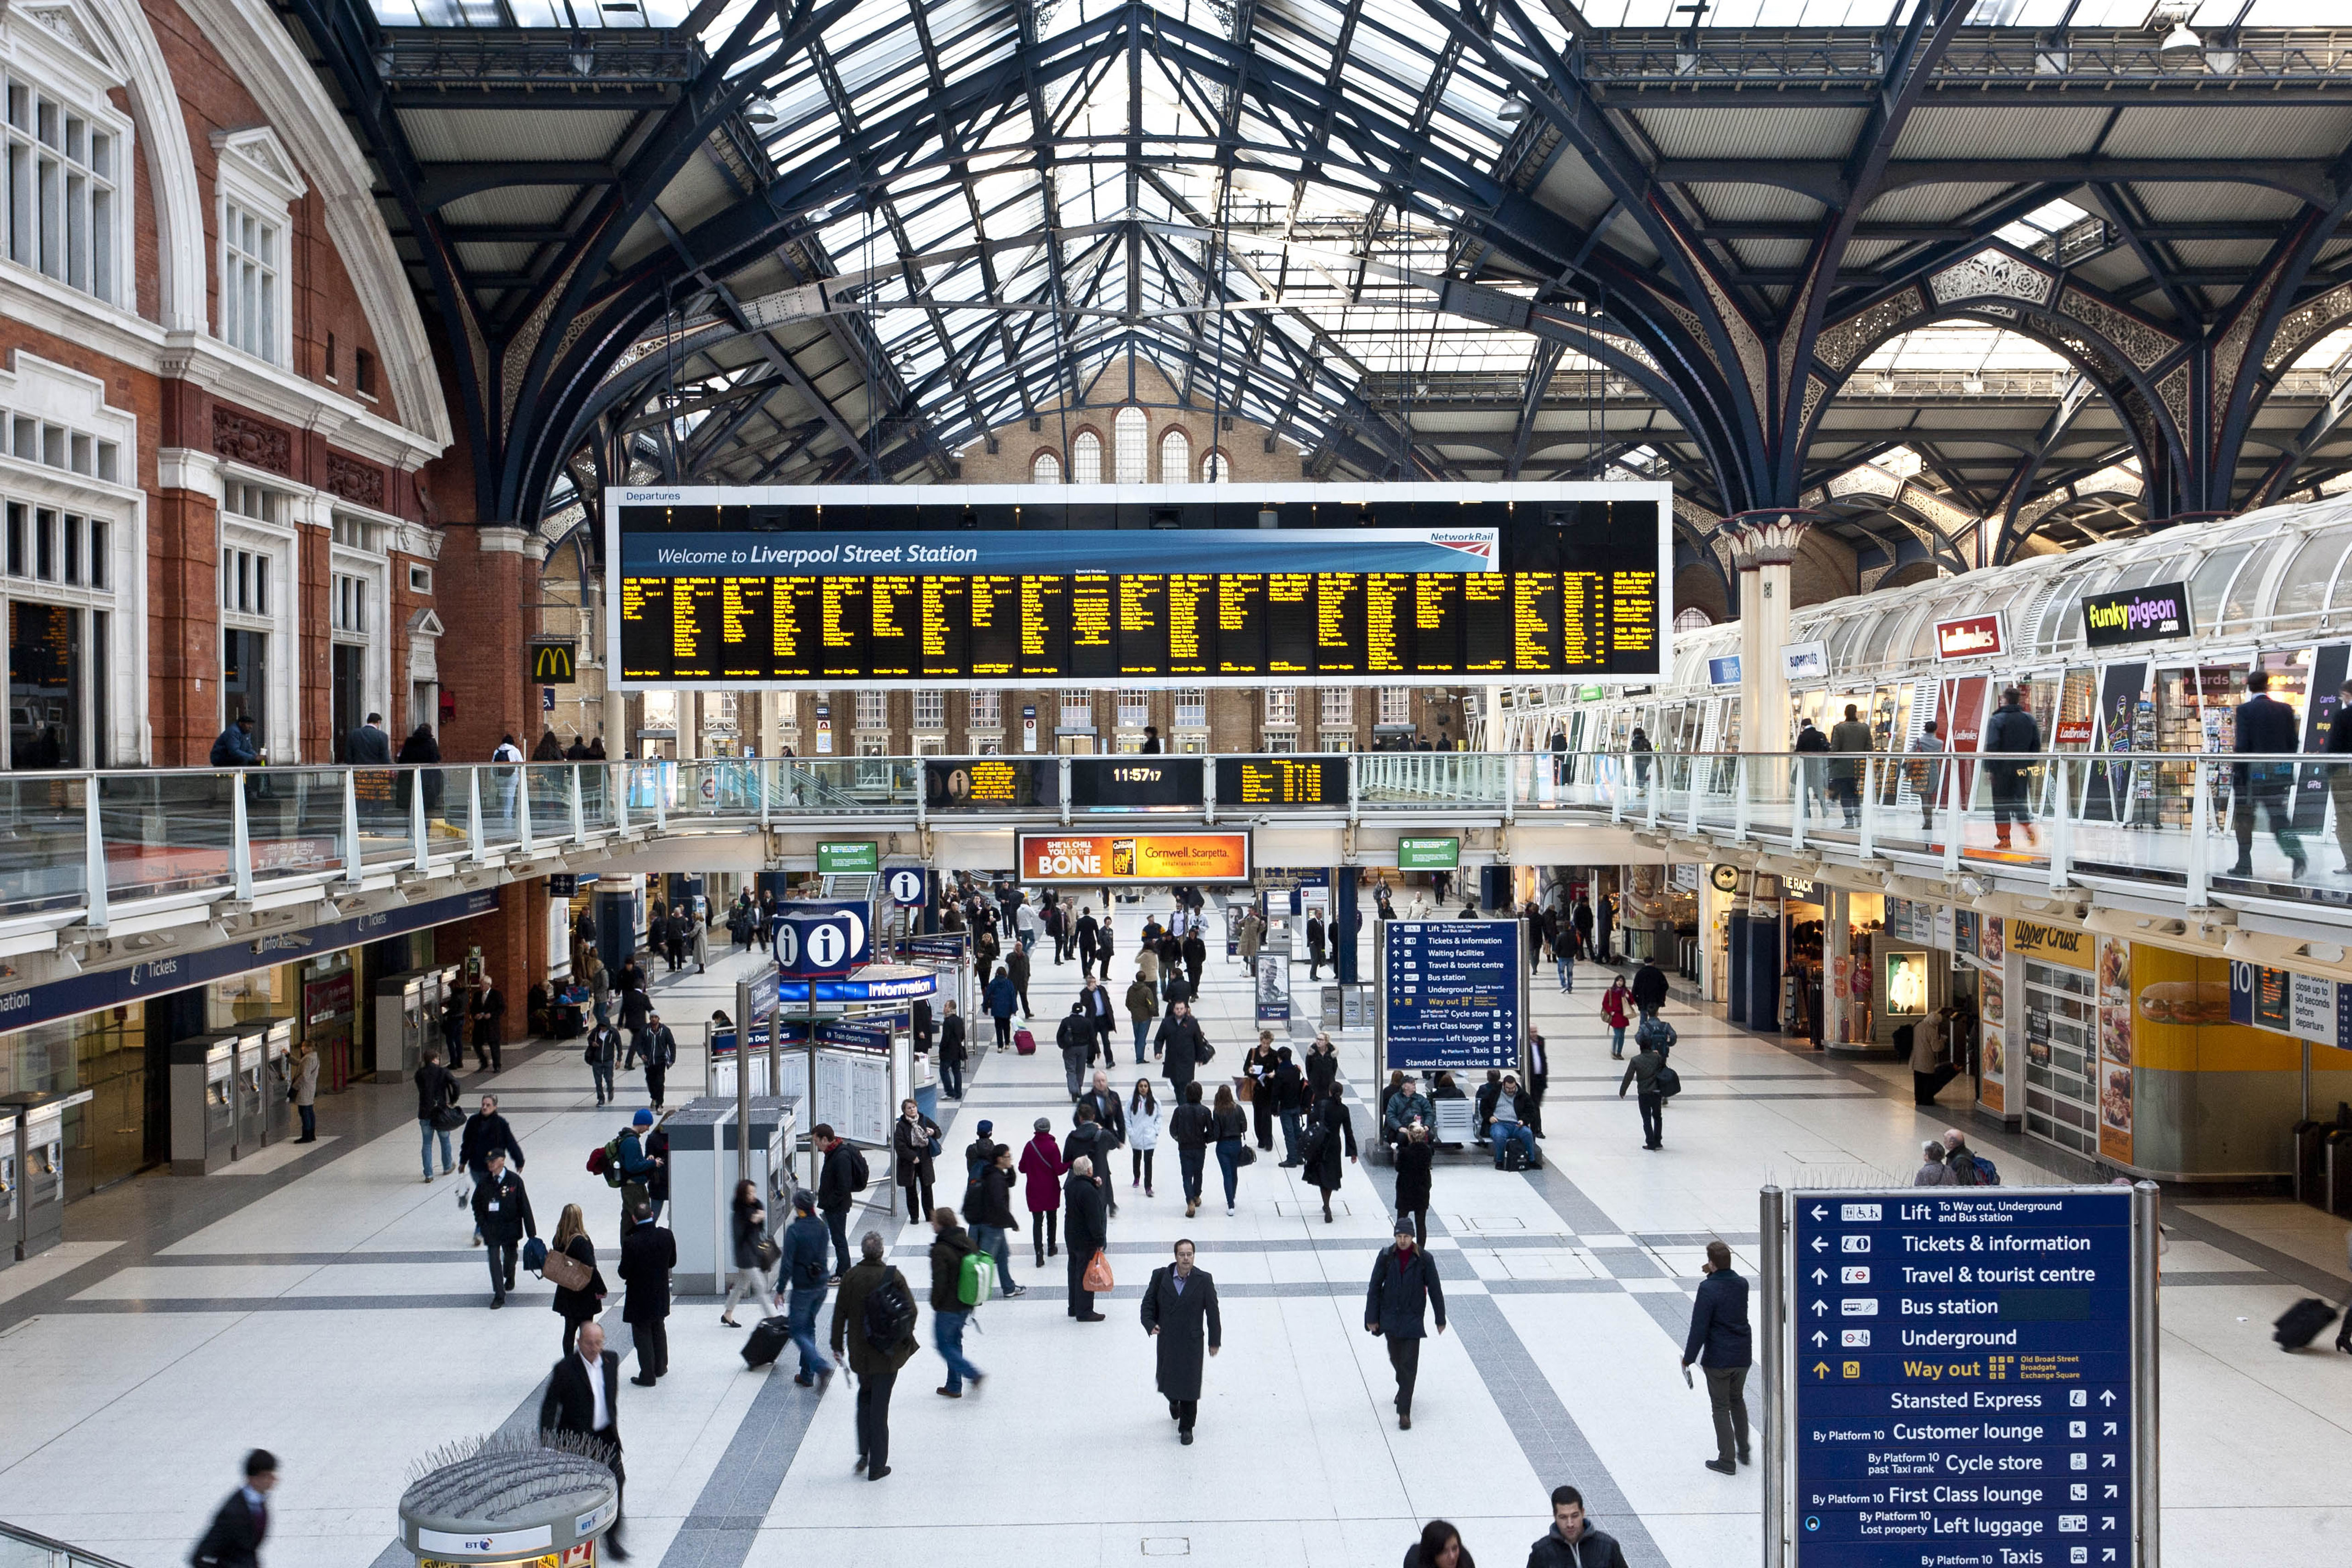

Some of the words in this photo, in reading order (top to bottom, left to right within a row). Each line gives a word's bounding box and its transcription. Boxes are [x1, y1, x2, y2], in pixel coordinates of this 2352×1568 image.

[626, 492, 680, 502] Departures
[658, 548, 727, 563] Welcome
[731, 550, 746, 563] to
[751, 544, 839, 568] Liverpool
[842, 544, 903, 563] Street
[906, 544, 978, 562] Station
[2160, 619, 2178, 632] .com
[1790, 651, 1818, 670] supercuts
[2320, 695, 2336, 704] Cards
[2059, 726, 2091, 740] Ladbrokes
[2317, 722, 2331, 731] Wrap
[2307, 780, 2321, 789] Gifts
[1145, 846, 1190, 858] Cornwell.
[1192, 848, 1229, 860] Scarpetta.
[1039, 855, 1101, 874] BONE
[1781, 875, 1793, 889] TIE
[1793, 877, 1813, 893] RACK
[368, 913, 386, 927] Tickets
[2015, 920, 2047, 947] Upper
[2047, 927, 2082, 952] Crust
[1428, 950, 1454, 958] Waiting
[147, 959, 177, 978] Tickets
[2230, 960, 2251, 993] 10
[868, 980, 931, 997] Information
[1428, 986, 1473, 995] Underground
[2295, 983, 2311, 993] close
[2312, 986, 2320, 995] up
[2322, 987, 2328, 996] to
[1428, 998, 1445, 1007] Way
[2295, 994, 2303, 1002] 30
[2304, 996, 2329, 1008] seconds
[1451, 1010, 1470, 1019] Cycle
[2295, 1007, 2314, 1017] before
[1459, 1022, 1483, 1031] lounge
[2295, 1018, 2324, 1032] departure
[846, 1032, 871, 1044] departures
[1462, 1034, 1489, 1043] luggage
[1438, 1059, 1465, 1067] Express
[1901, 1204, 1932, 1220] Lift
[1938, 1201, 1951, 1211] To
[1952, 1201, 1974, 1213] Way
[1976, 1202, 1996, 1211] out,
[1998, 1201, 2062, 1213] Underground
[1938, 1212, 1956, 1222] and
[1959, 1212, 1977, 1222] Bus
[1979, 1213, 2013, 1222] station
[1902, 1235, 1965, 1251] Tickets
[1970, 1235, 1984, 1251] &
[1989, 1234, 2090, 1251] information
[1901, 1267, 1953, 1283] Travel
[1958, 1266, 1973, 1283] &
[1977, 1267, 2035, 1282] tourist
[2040, 1267, 2095, 1282] centre
[1901, 1298, 1934, 1314] Bus
[1938, 1299, 1998, 1314] station
[1901, 1328, 2017, 1347] Underground
[1903, 1361, 1943, 1381] Way
[1949, 1361, 1981, 1376] out
[2020, 1372, 2054, 1380] Exchange
[2056, 1371, 2080, 1380] Square
[1891, 1392, 1968, 1409] Stansted
[1974, 1392, 2042, 1411] Express
[1813, 1431, 1826, 1443] By
[1829, 1431, 1871, 1440] Platform
[1873, 1430, 1885, 1440] 10
[1893, 1423, 1979, 1440] Customer
[1984, 1422, 2043, 1442] lounge
[1868, 1453, 1881, 1465] By
[1884, 1453, 1926, 1462] Platform
[1928, 1452, 1940, 1462] 10
[1946, 1454, 1994, 1474] Cycle
[1998, 1455, 2043, 1470] store
[1868, 1465, 1889, 1476] past
[1891, 1464, 1911, 1474] Taxi
[1913, 1464, 1934, 1473] rank
[1813, 1494, 1826, 1506] By
[1828, 1494, 1870, 1504] Platform
[1872, 1493, 1884, 1503] 10
[1889, 1487, 1928, 1503] First
[1933, 1486, 1979, 1502] Class
[1984, 1486, 2043, 1505] lounge
[1860, 1511, 1873, 1523] By
[1875, 1511, 1917, 1521] Platform
[1919, 1511, 1931, 1521] 10
[581, 1521, 591, 1530] BT
[1861, 1524, 1883, 1534] Lost
[1884, 1525, 1928, 1536] property
[1934, 1517, 1969, 1533] Left
[1974, 1517, 2043, 1536] luggage
[1922, 1556, 1934, 1567] By
[1937, 1555, 1979, 1565] Platform
[1981, 1555, 1993, 1564] 10
[1999, 1548, 2043, 1564] Taxis
